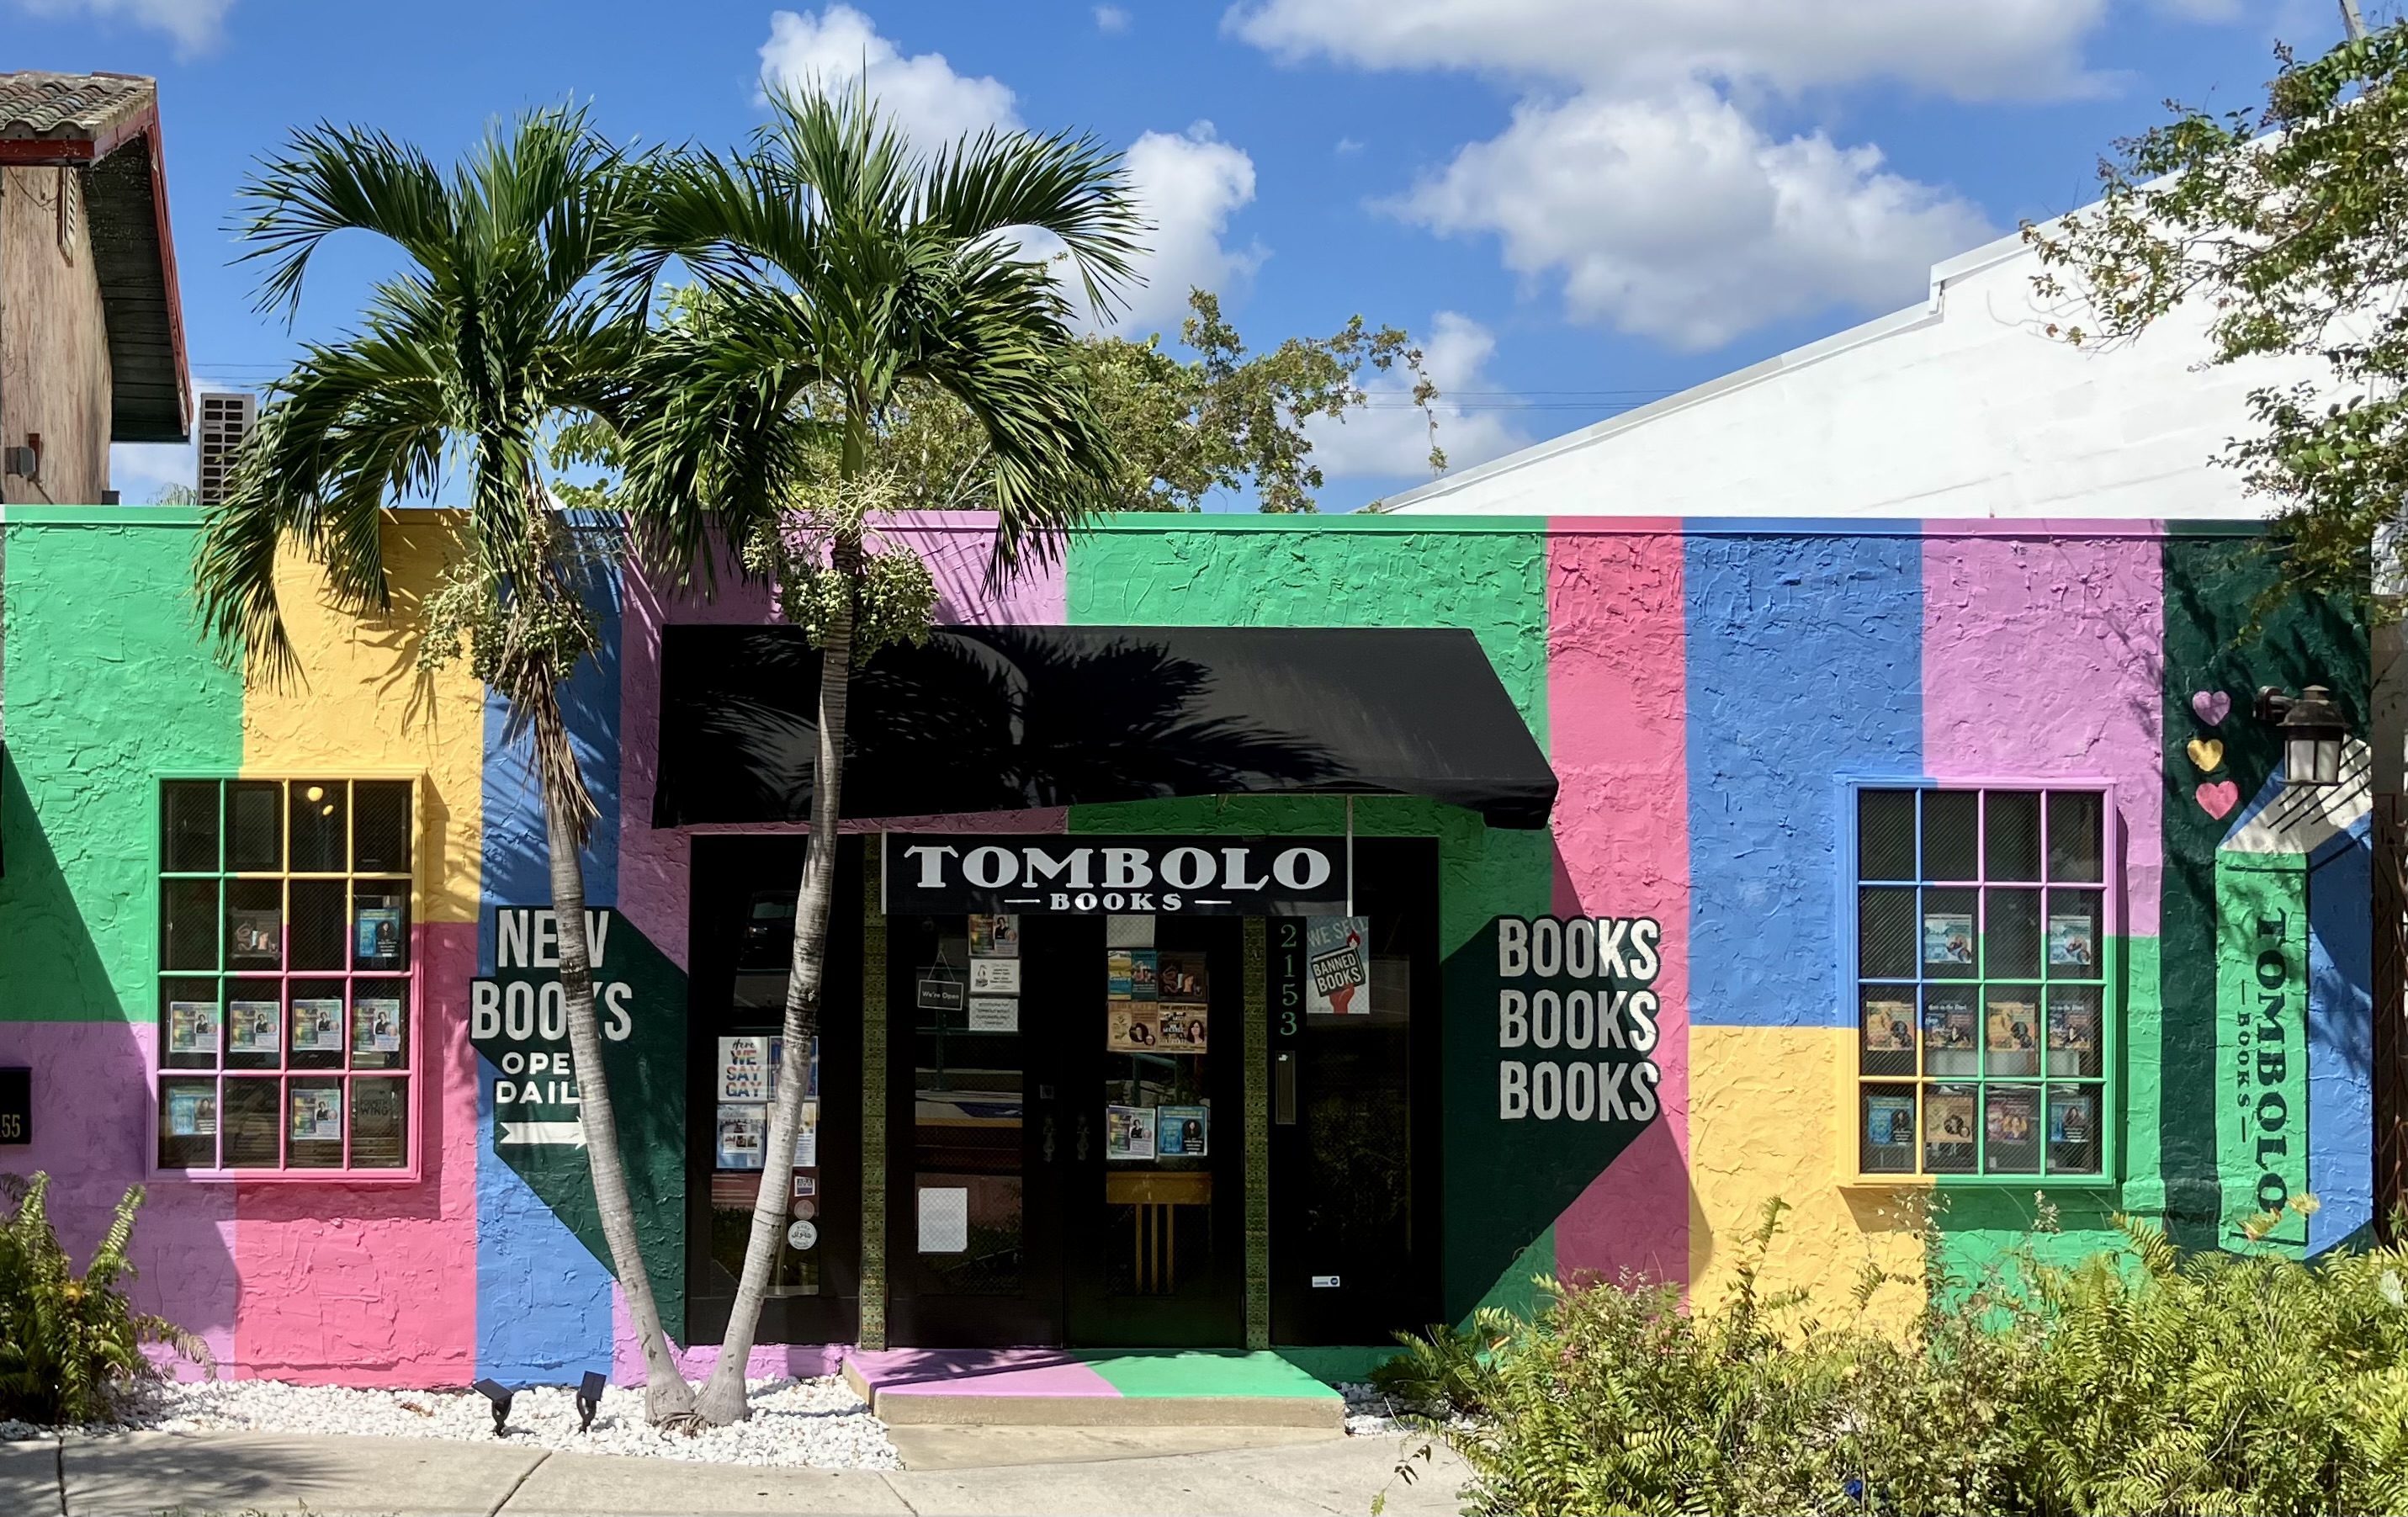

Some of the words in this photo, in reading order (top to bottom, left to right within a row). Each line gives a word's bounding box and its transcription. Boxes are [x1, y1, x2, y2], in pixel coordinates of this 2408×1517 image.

[904, 846, 1331, 890] TOMBOLO
[1050, 893, 1182, 910] BOOKS
[1307, 926, 1331, 947] WE
[1498, 918, 1661, 980] BOOKS
[1313, 952, 1357, 977] BANNED
[1280, 924, 1298, 1036] 2153
[1317, 967, 1361, 993] BOOKS
[471, 980, 633, 1042] BOOS
[1499, 989, 1659, 1051] BOOKS
[732, 1038, 756, 1051] Here
[502, 1052, 571, 1074] OPE
[730, 1050, 756, 1065] WE
[2236, 1012, 2251, 1108] BOOKS
[2255, 908, 2288, 1214] TOMBOLO
[726, 1066, 761, 1081] SAY
[496, 1080, 582, 1104] DAIL
[726, 1082, 762, 1097] GAY
[1500, 1060, 1659, 1122] BOOKS
